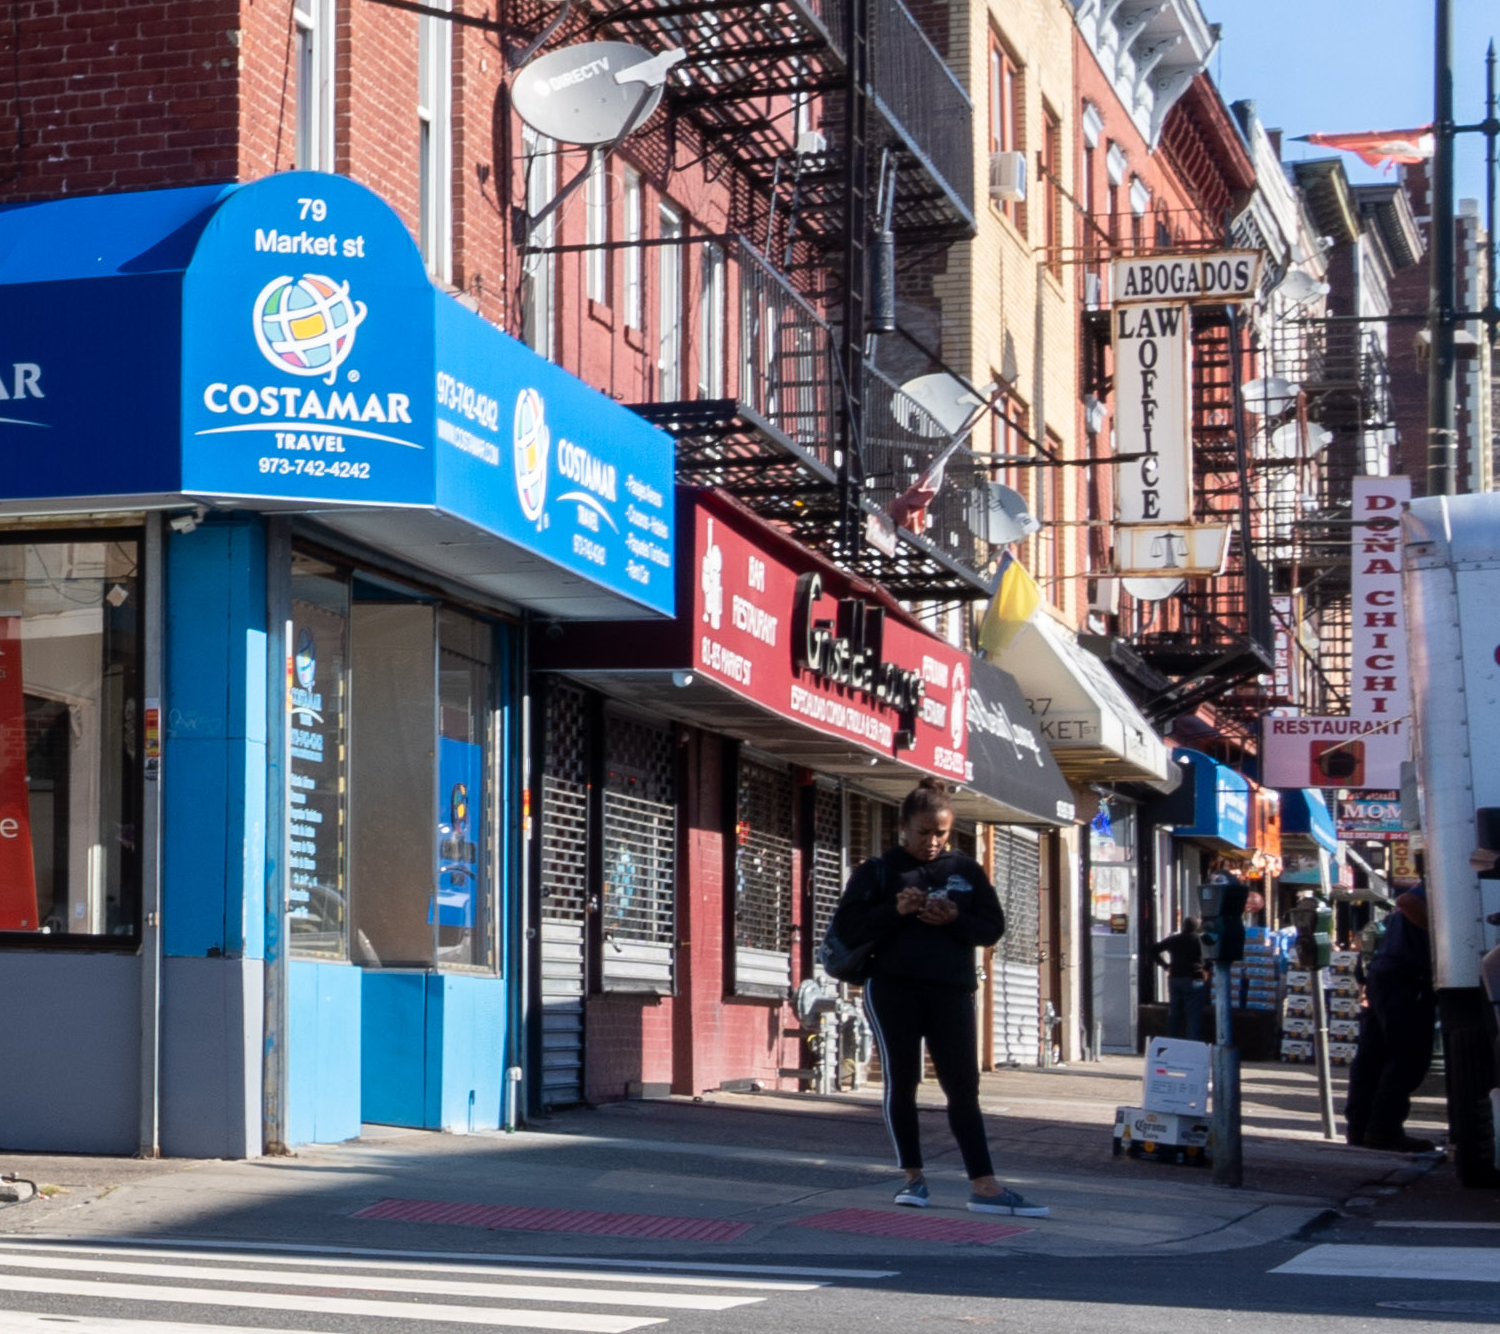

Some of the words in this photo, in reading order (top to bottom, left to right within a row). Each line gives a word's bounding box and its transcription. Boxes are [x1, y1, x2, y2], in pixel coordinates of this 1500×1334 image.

[297, 198, 327, 222] 79
[255, 228, 337, 257] Market
[342, 235, 365, 258] st
[1124, 260, 1249, 296] ABOGADOS
[1118, 306, 1181, 339] LAW
[203, 382, 412, 424] COSTAMAR
[275, 432, 346, 453] TRAVEL
[1137, 338, 1162, 519] OFFICE
[258, 457, 371, 479] 973-742-4242
[557, 438, 617, 503] COSTAMAR
[1362, 495, 1401, 575] DOÑA
[748, 555, 765, 593] BAR
[732, 593, 778, 647] RESTAURANT
[1363, 590, 1397, 714] CHICHI
[1272, 719, 1403, 736] RESTAURANT
